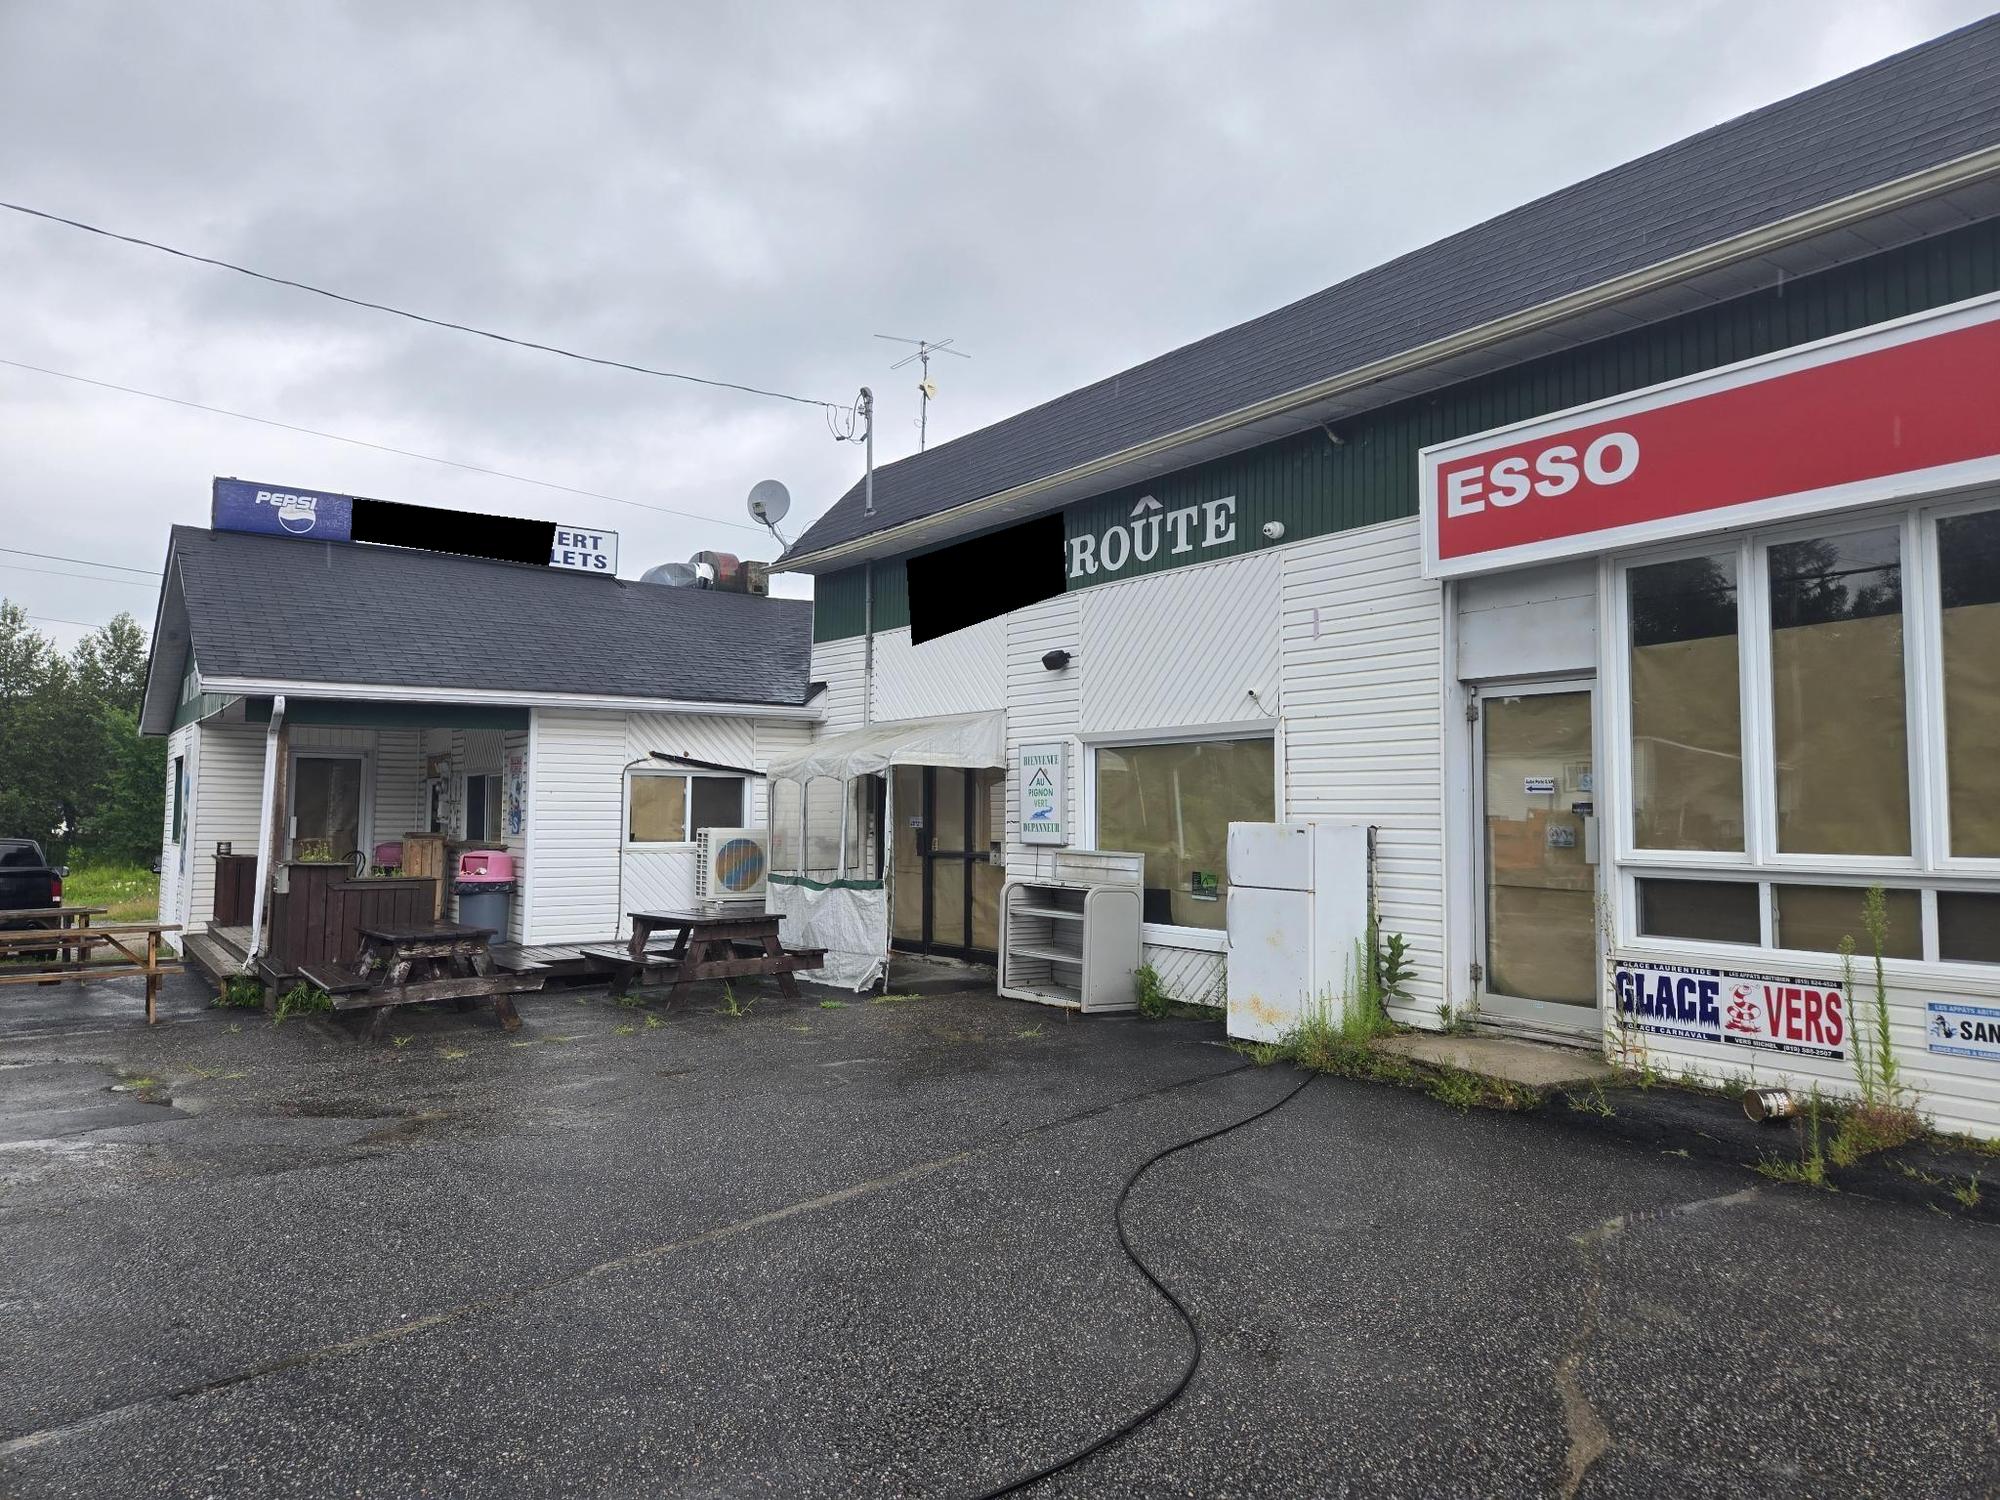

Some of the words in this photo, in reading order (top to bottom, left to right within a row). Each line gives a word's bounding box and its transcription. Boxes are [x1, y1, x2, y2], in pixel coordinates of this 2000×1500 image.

[1447, 432, 1640, 518] ESSO
[255, 491, 317, 510] PEPSI
[558, 531, 603, 550] ERT
[1065, 494, 1236, 578] ROÛTE
[1024, 755, 1058, 766] BIENVENUE
[1036, 778, 1044, 786] AU
[1028, 788, 1053, 797] PIGNON
[1034, 799, 1048, 807] VERT
[1653, 964, 1711, 975] LAURENTIDE
[1616, 972, 1720, 1030] GLACE
[1763, 985, 1843, 1046] VERS
[1628, 1023, 1656, 1032] GACE
[1659, 1027, 1708, 1040] CARNAVAL
[1961, 1021, 2000, 1043] SAN
[1735, 1038, 1751, 1046] VERS
